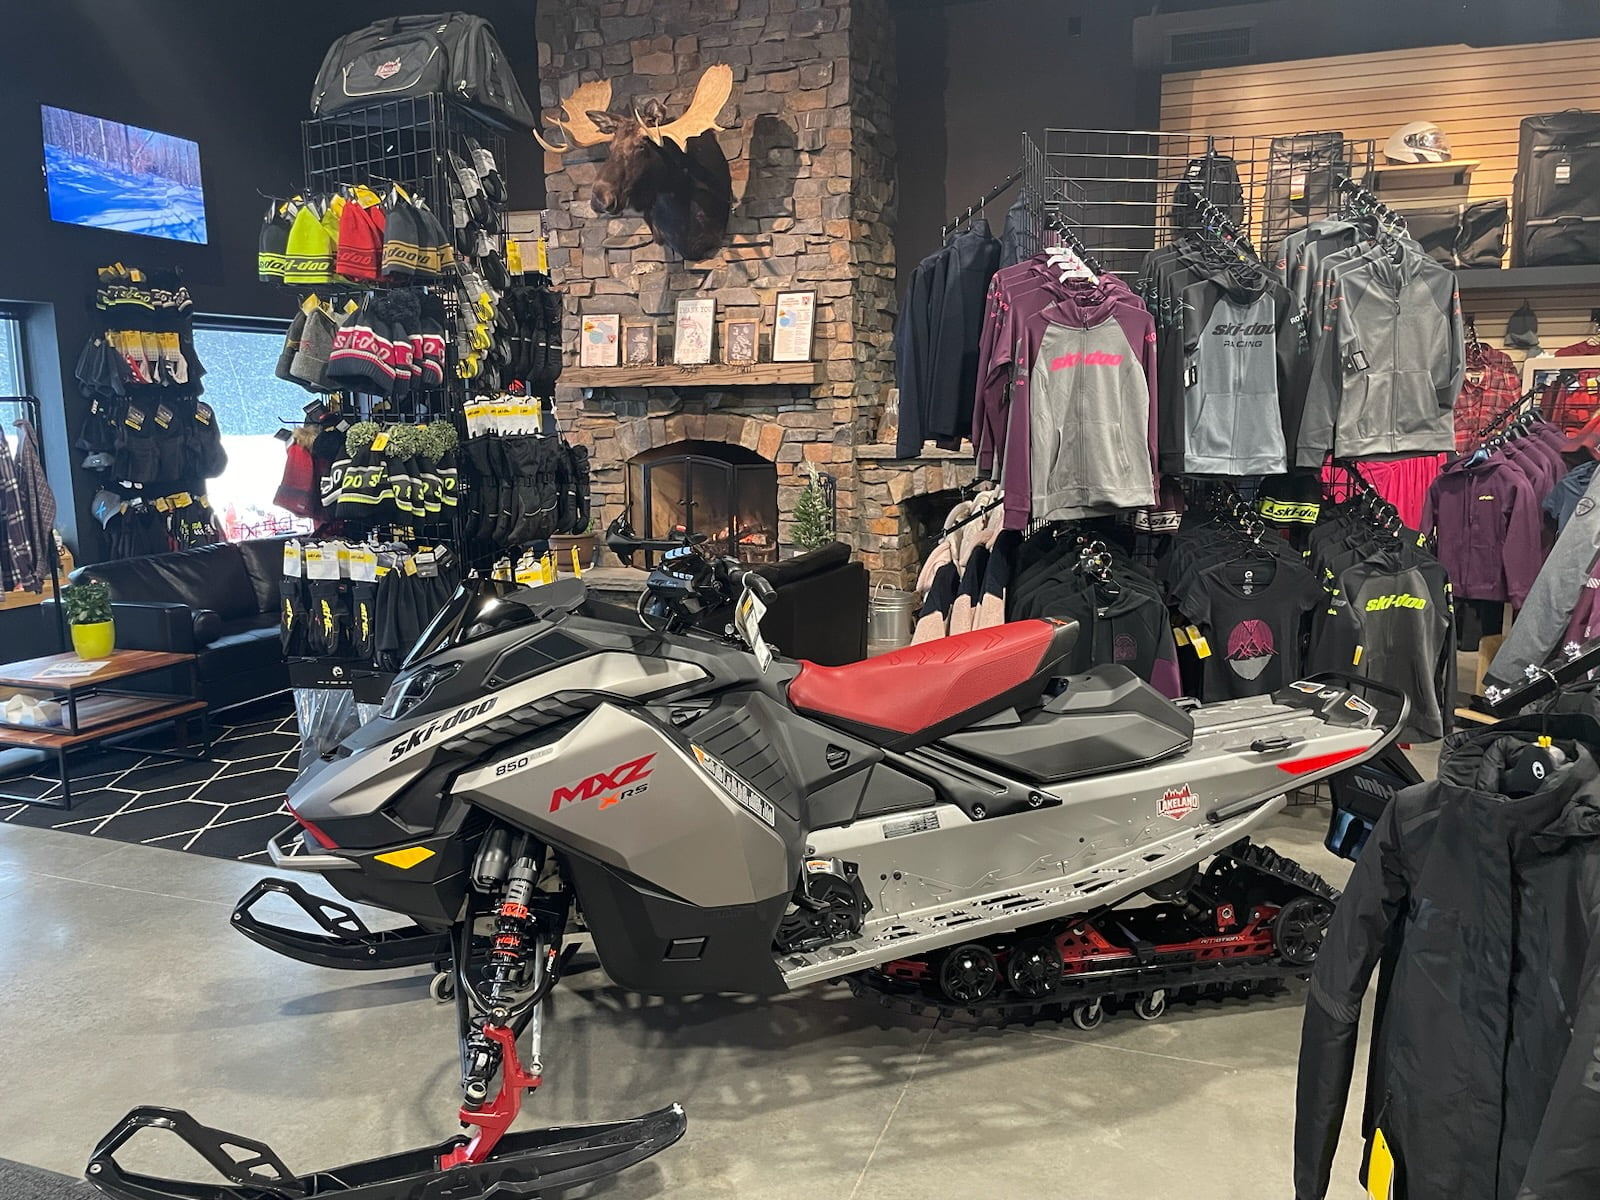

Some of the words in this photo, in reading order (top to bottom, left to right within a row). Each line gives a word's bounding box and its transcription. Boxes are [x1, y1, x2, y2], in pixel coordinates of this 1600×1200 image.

[1366, 593, 1427, 612] ski-doo
[389, 696, 499, 762] ski-doo
[496, 757, 529, 776] 850
[549, 752, 658, 813] MXZ
[1157, 795, 1198, 815] LAKELAND
